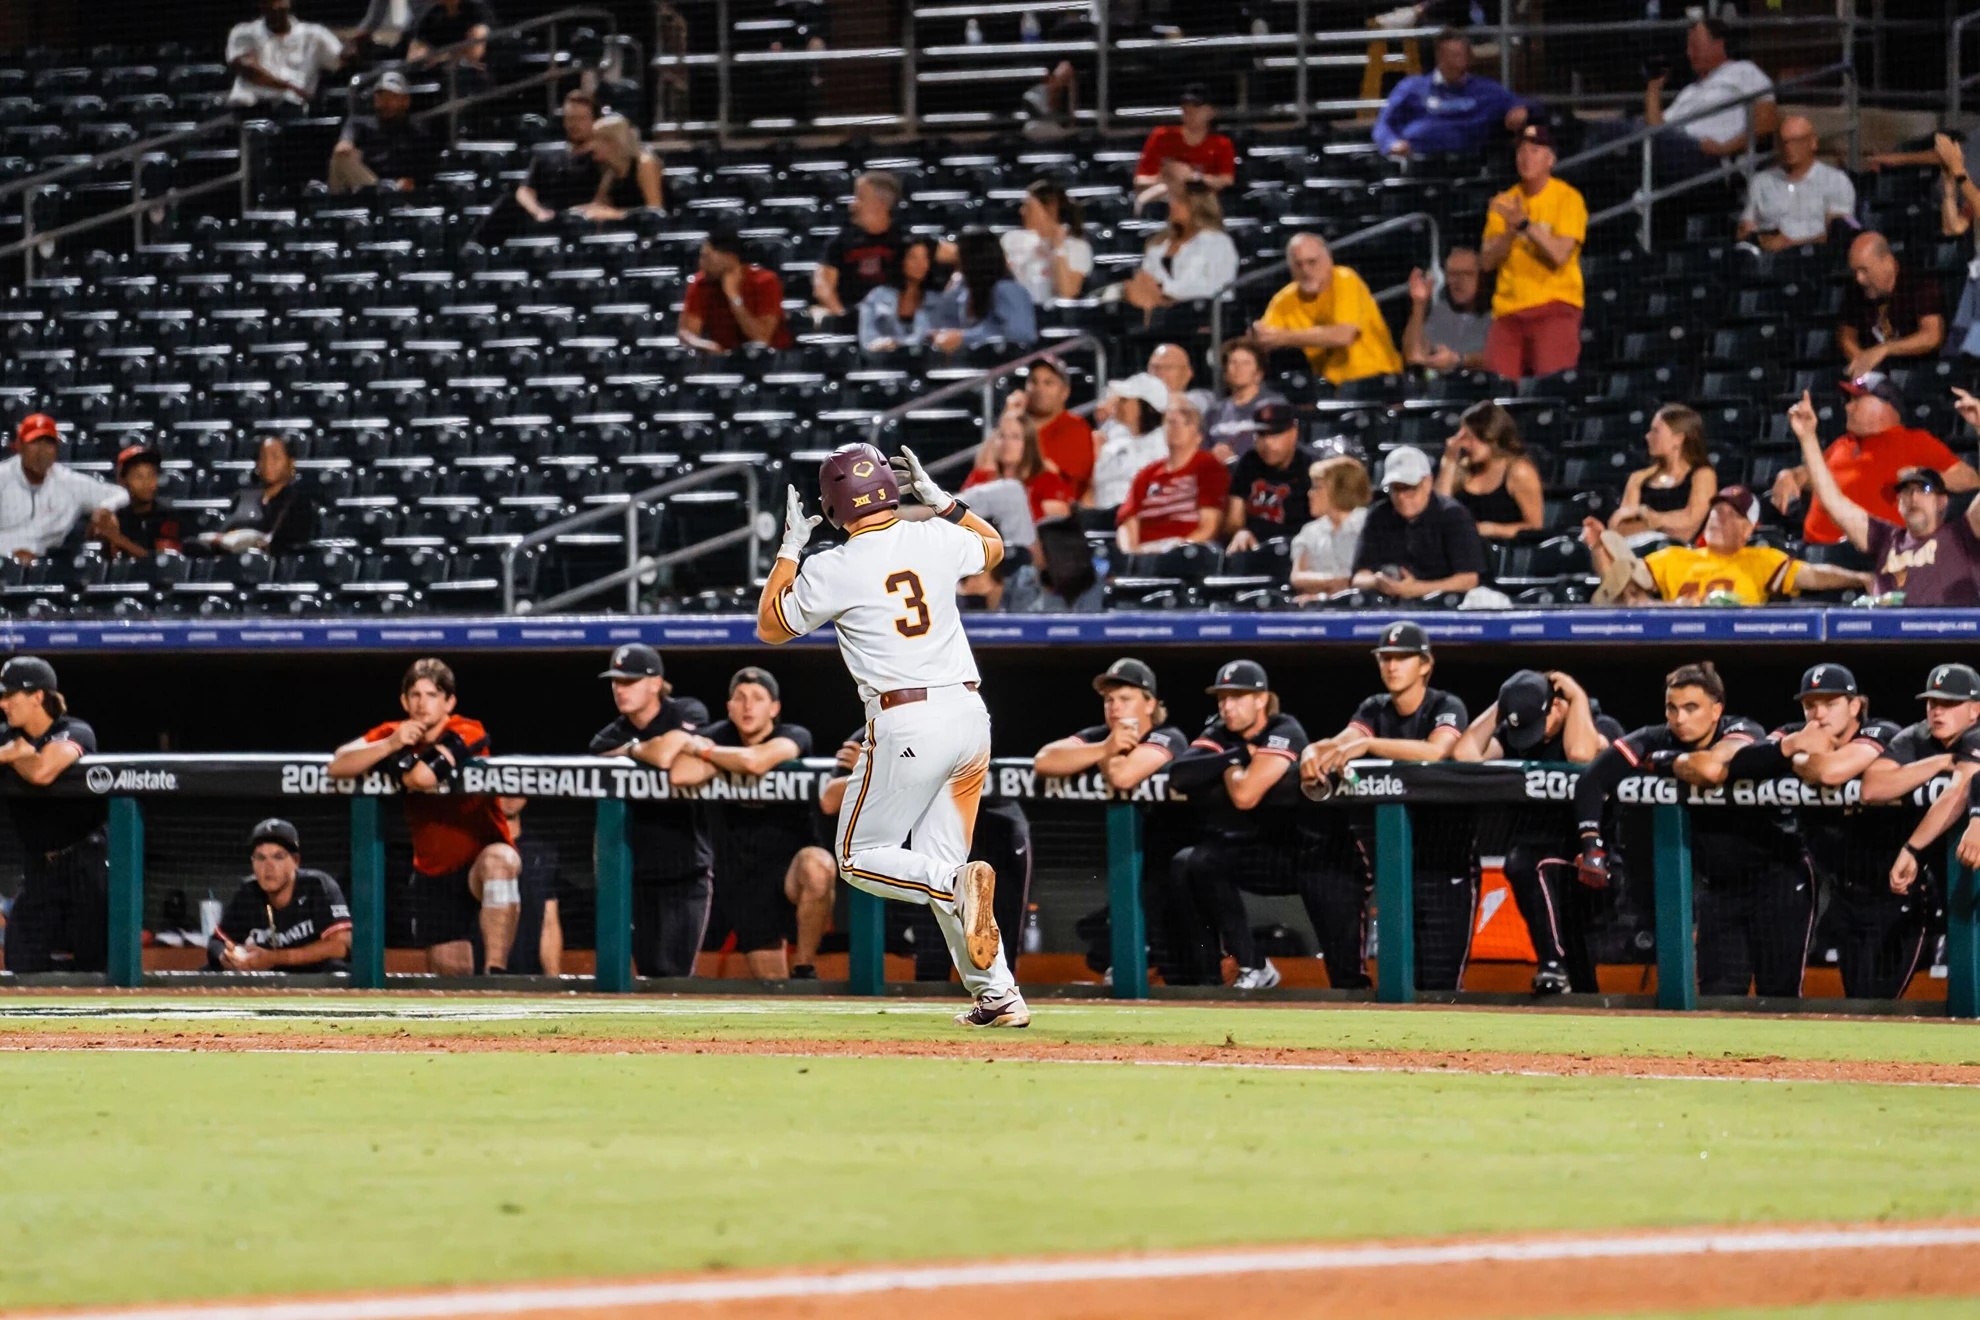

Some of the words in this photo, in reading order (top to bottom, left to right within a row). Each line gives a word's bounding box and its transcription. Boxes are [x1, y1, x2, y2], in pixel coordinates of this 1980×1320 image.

[885, 569, 931, 638] 3
[113, 769, 177, 791] Allstate
[463, 766, 607, 798] BASEBALL
[1000, 767, 1037, 798] BY
[1617, 776, 1679, 804] BIG
